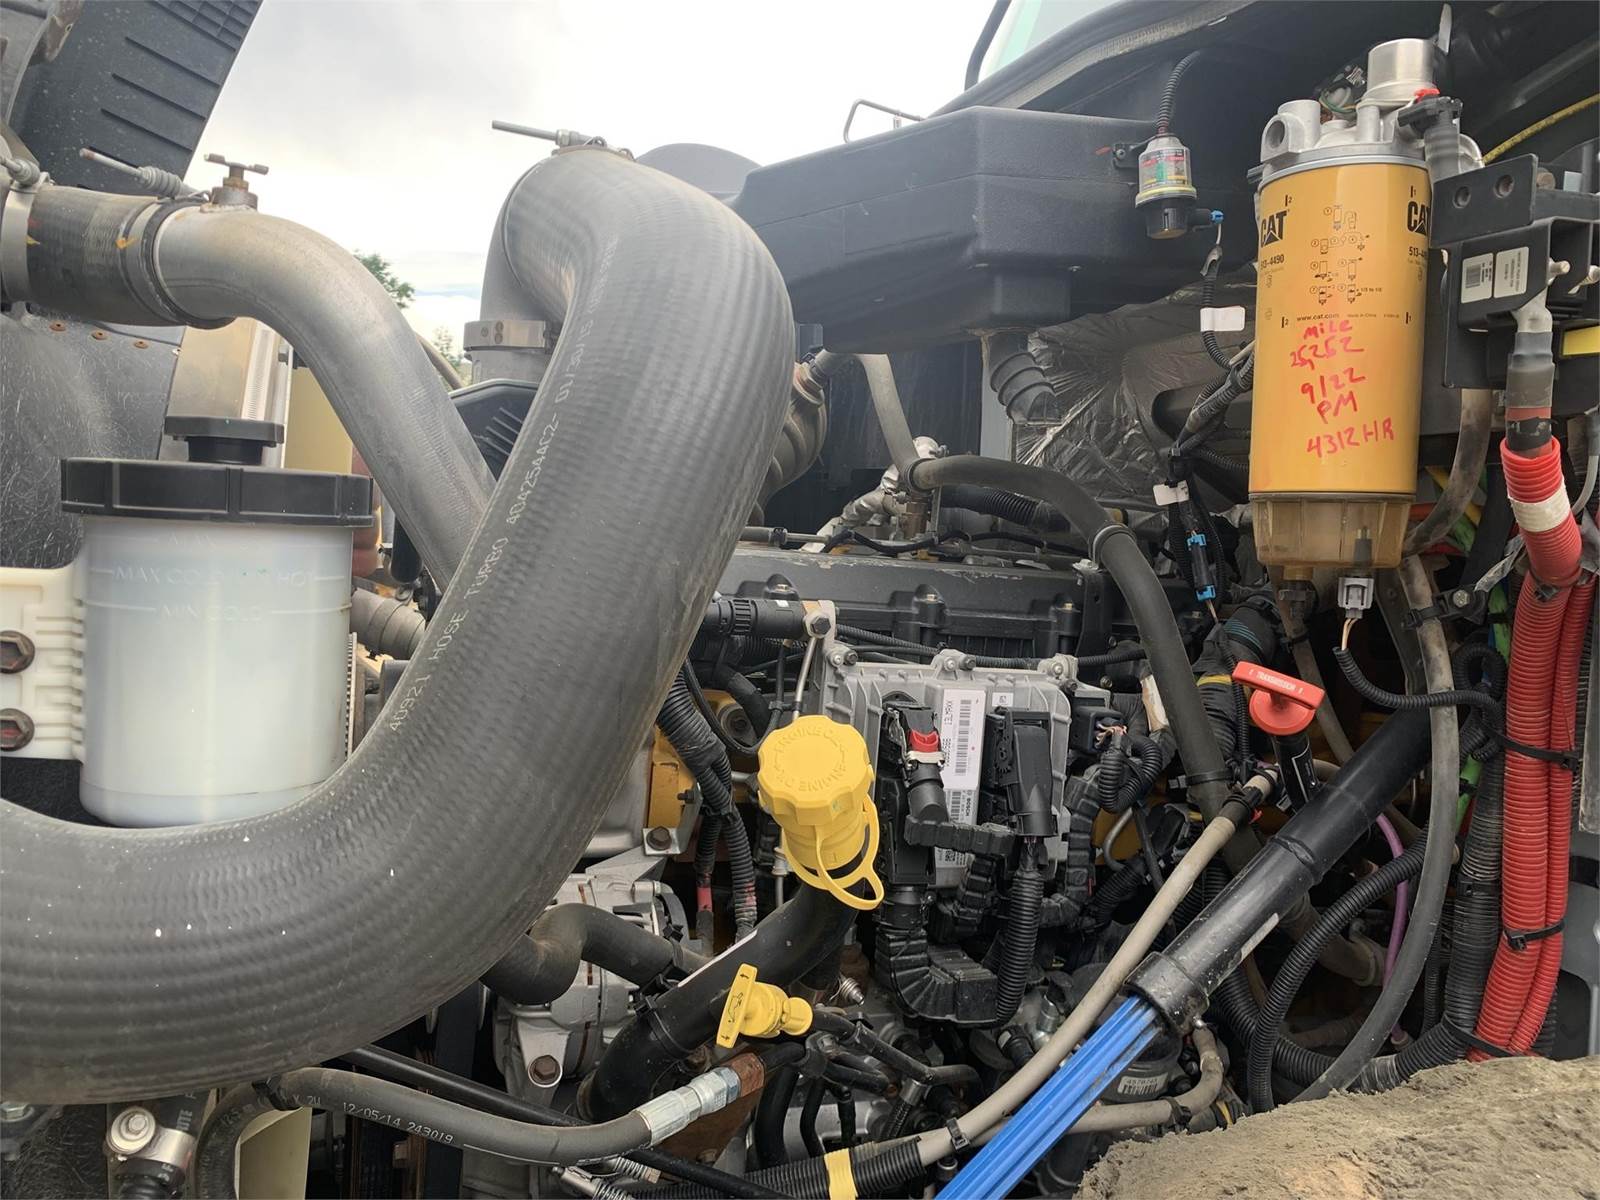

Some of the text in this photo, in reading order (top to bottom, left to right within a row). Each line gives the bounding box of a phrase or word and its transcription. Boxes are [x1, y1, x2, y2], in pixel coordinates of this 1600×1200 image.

[1260, 210, 1288, 248] CAT
[1297, 313, 1340, 322] www.cat.com
[115, 566, 161, 585] MAX
[429, 609, 470, 662] HOSE
[463, 537, 510, 600] TURBO
[343, 1102, 401, 1128] 12/05/14
[406, 1121, 454, 1144] 243019
